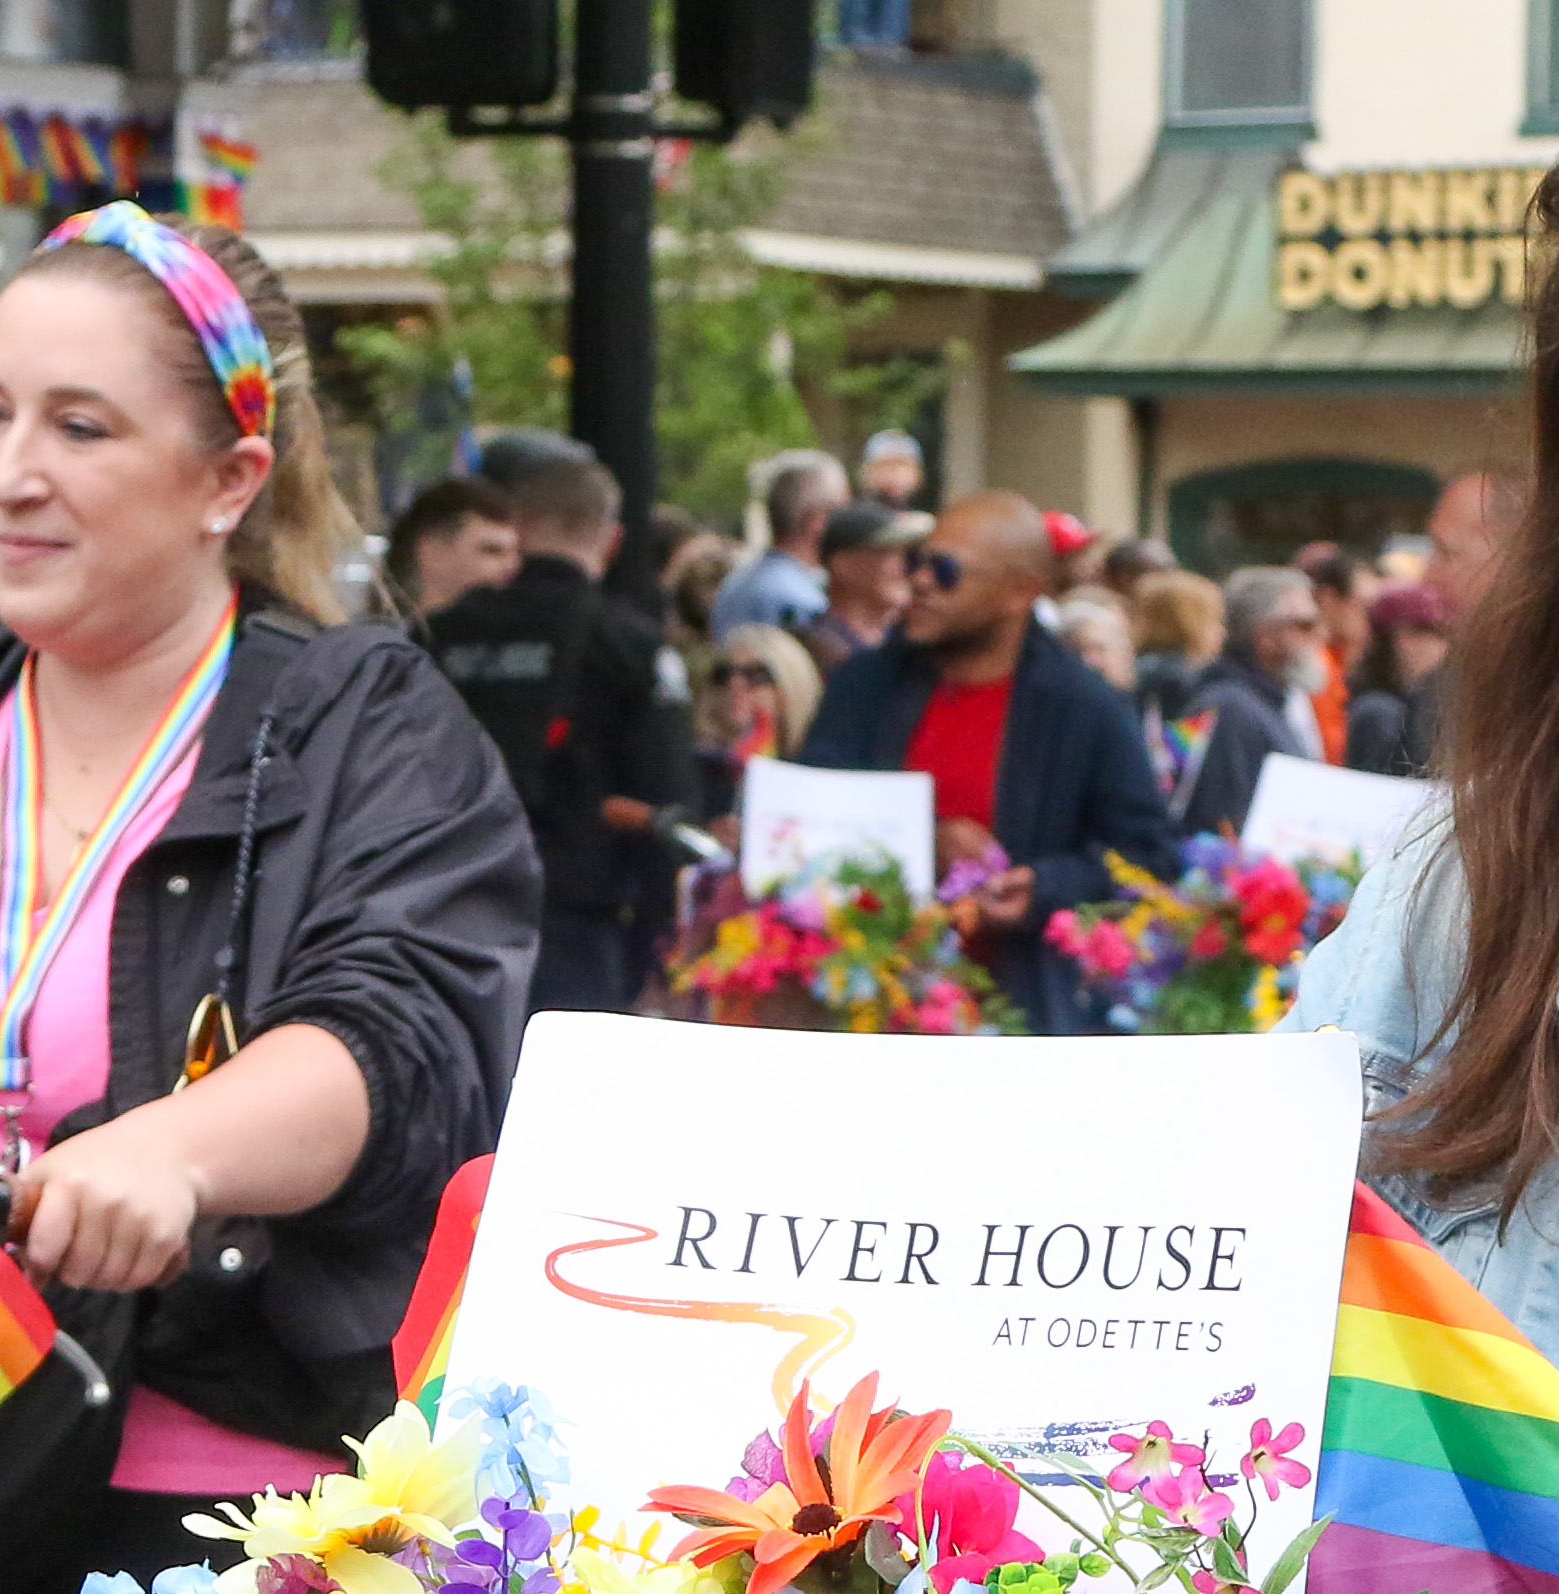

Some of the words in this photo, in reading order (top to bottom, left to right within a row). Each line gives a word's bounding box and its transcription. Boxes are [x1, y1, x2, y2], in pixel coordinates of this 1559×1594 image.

[1279, 171, 1546, 234] DUNKI
[665, 1205, 941, 1286] RIVER
[970, 1222, 1248, 1292] HOUSE
[992, 1317, 1037, 1347] AT
[1046, 1317, 1225, 1353] ODETTE'S
